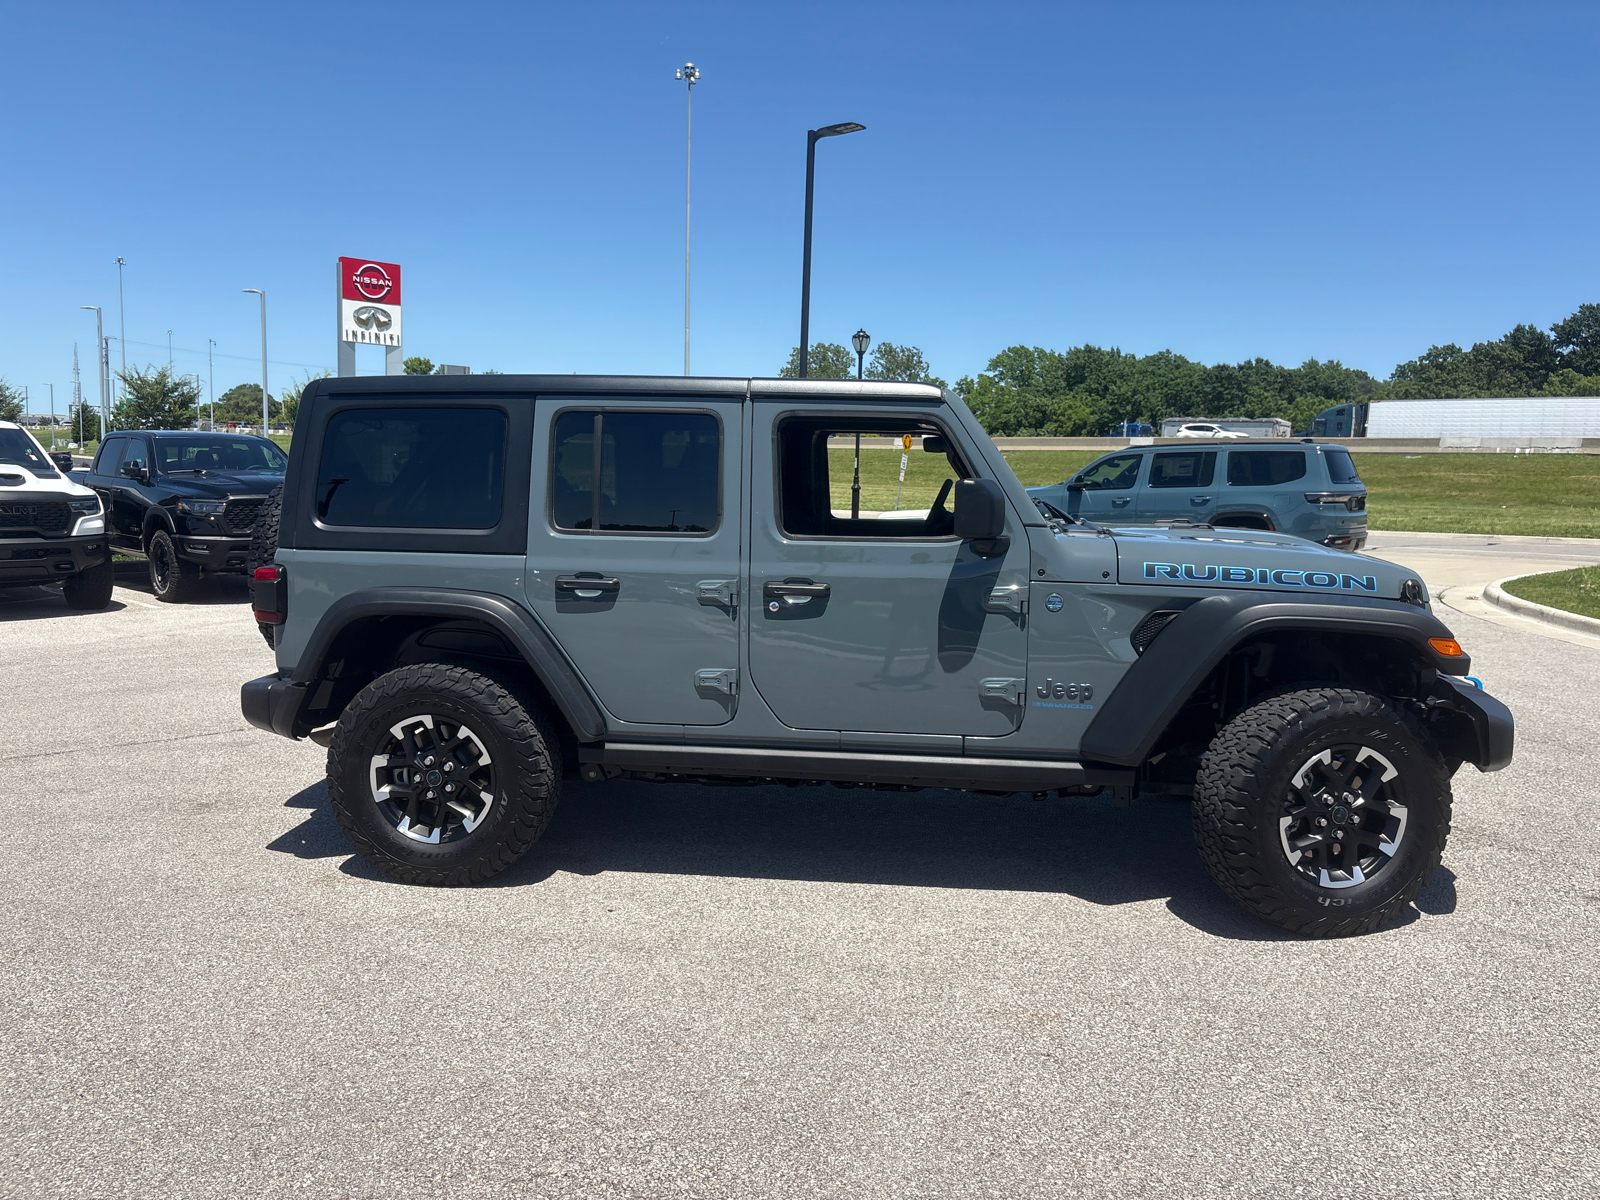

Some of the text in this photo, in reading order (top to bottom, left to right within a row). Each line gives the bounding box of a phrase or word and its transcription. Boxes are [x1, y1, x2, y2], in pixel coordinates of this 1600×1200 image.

[353, 276, 392, 286] NISSAN
[345, 329, 400, 346] INFINITI
[1143, 561, 1377, 592] RUBICON
[1037, 678, 1093, 703] Jeep
